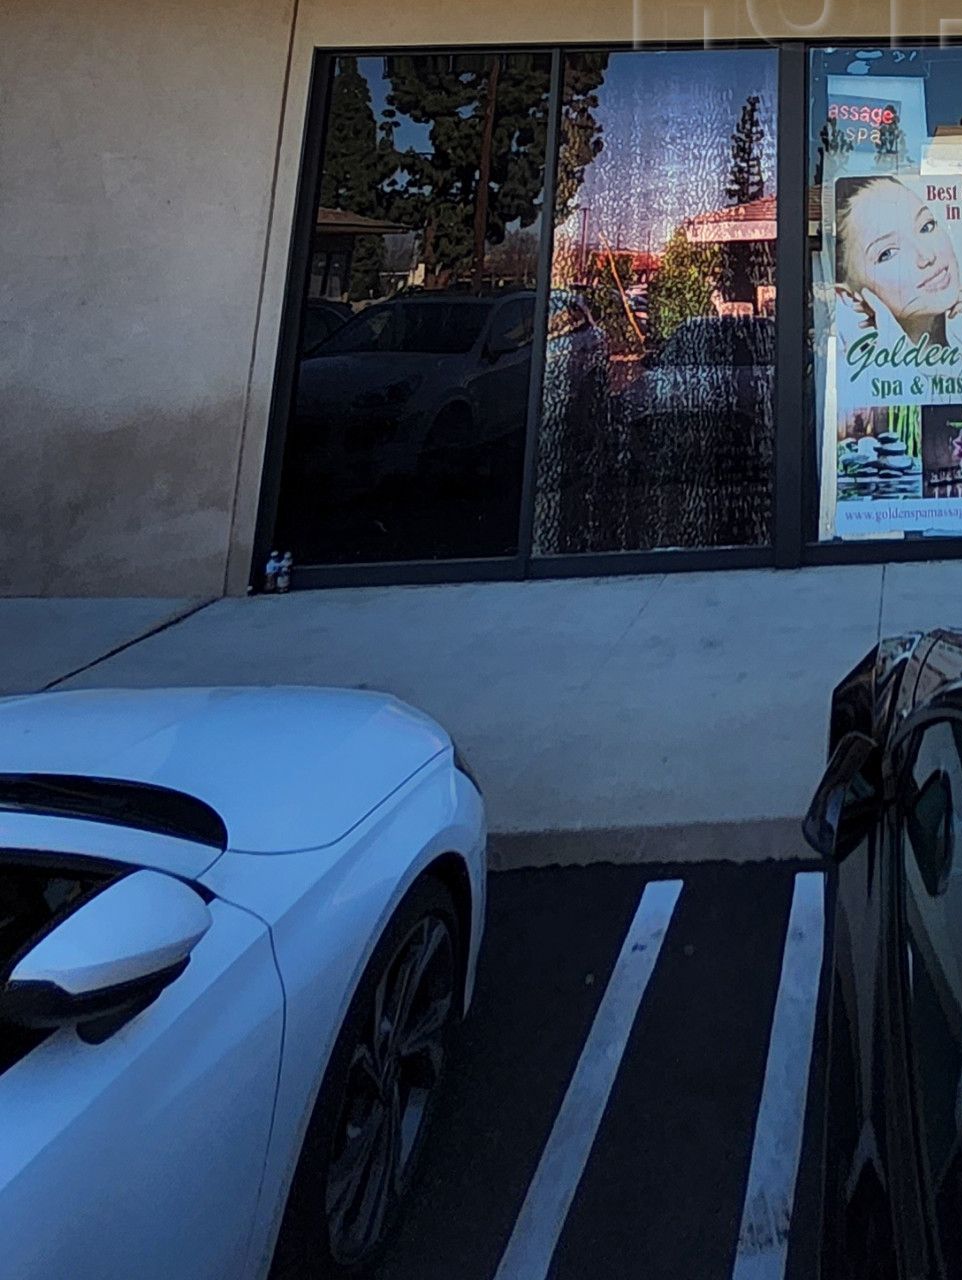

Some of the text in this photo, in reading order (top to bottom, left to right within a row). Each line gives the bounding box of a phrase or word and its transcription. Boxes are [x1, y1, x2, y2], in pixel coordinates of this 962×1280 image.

[828, 104, 894, 127] assage
[846, 126, 882, 146] spa
[926, 185, 957, 201] Best
[946, 204, 960, 220] in
[846, 332, 960, 382] Golden
[872, 377, 902, 398] Spa
[910, 376, 924, 395] &
